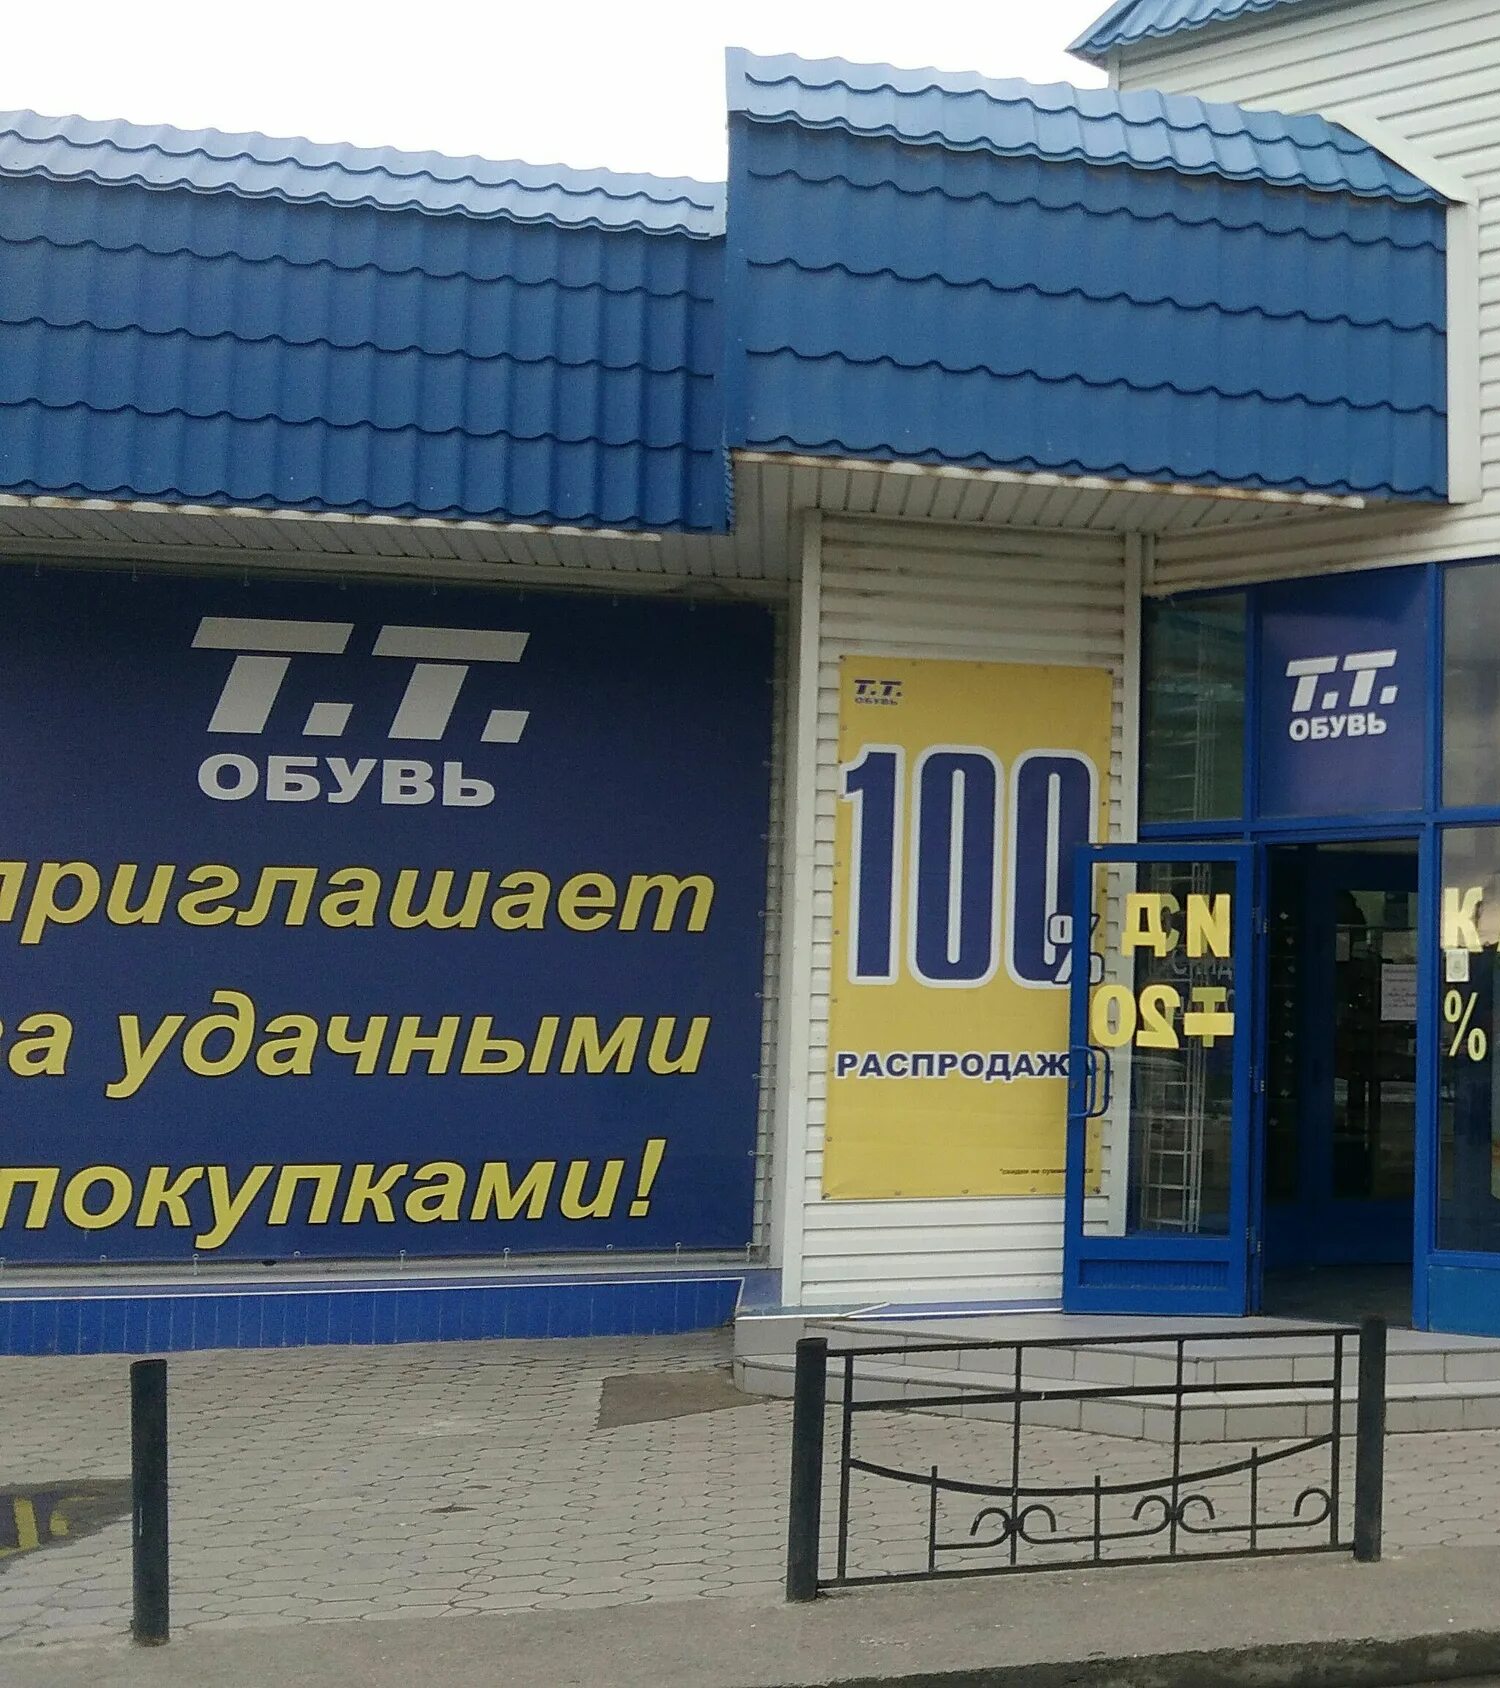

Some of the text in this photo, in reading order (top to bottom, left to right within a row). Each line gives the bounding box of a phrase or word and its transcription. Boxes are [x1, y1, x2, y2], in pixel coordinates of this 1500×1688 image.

[190, 616, 531, 744] Т.Т.
[1285, 648, 1398, 712] Т.Т.
[1288, 711, 1388, 742] ОБУВЬ
[196, 752, 497, 808] ОБУВЬ
[0, 989, 711, 1100] а удачными
[836, 1053, 1093, 1082] РАСПРОДАЖ
[0, 1138, 668, 1251] покупками!
